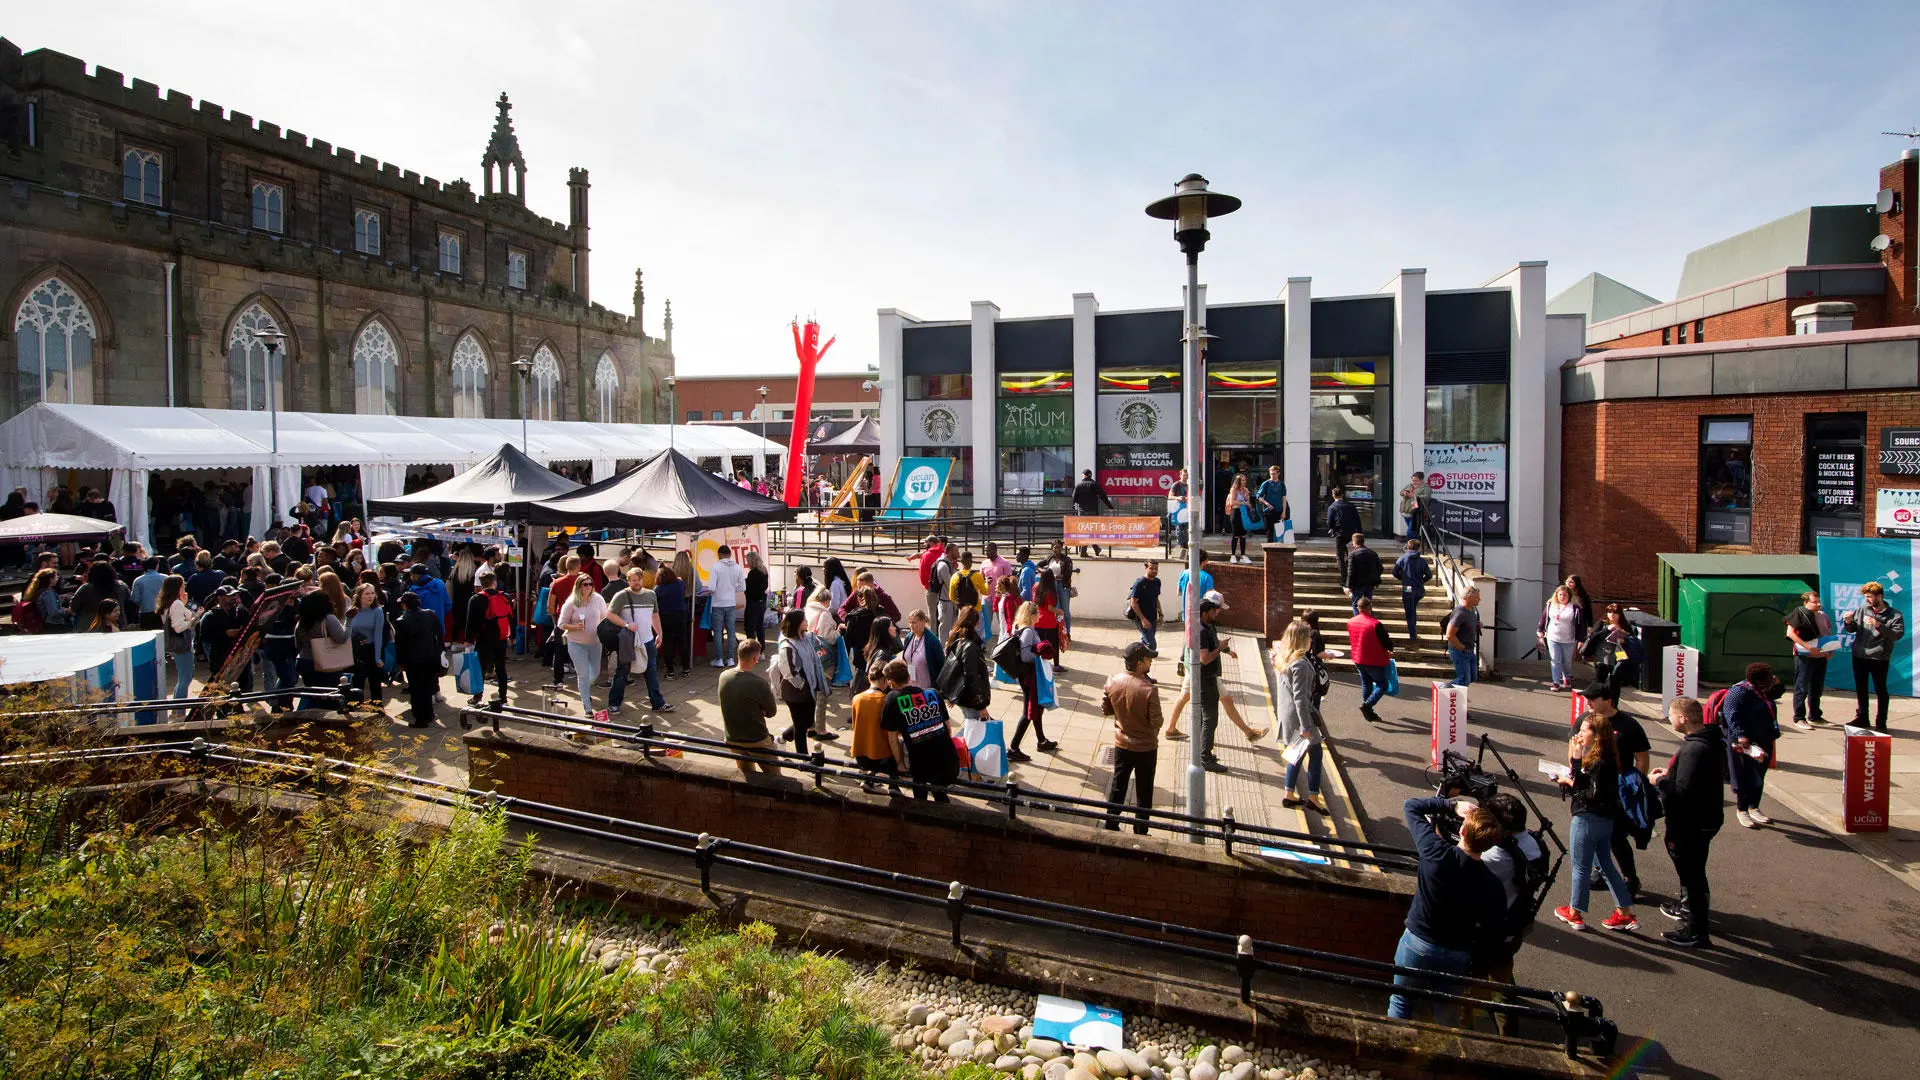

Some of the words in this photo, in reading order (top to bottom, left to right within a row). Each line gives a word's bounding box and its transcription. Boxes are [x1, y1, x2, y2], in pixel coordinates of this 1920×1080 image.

[1004, 406, 1065, 427] ATRIUM
[1105, 456, 1126, 464] uclan
[1818, 462, 1855, 470] COCKTAILS
[910, 472, 935, 482] uclan
[1105, 477, 1153, 487] ATRIUM
[910, 481, 933, 493] SU
[1446, 481, 1496, 490] UNION
[1824, 495, 1854, 505] COFFEE
[1676, 652, 1685, 697] WELCOME
[899, 691, 937, 709] USA
[902, 701, 941, 726] 1982
[1449, 692, 1457, 745] WELCOME
[1864, 740, 1876, 802] WELCOME
[1854, 814, 1882, 823] uclan
